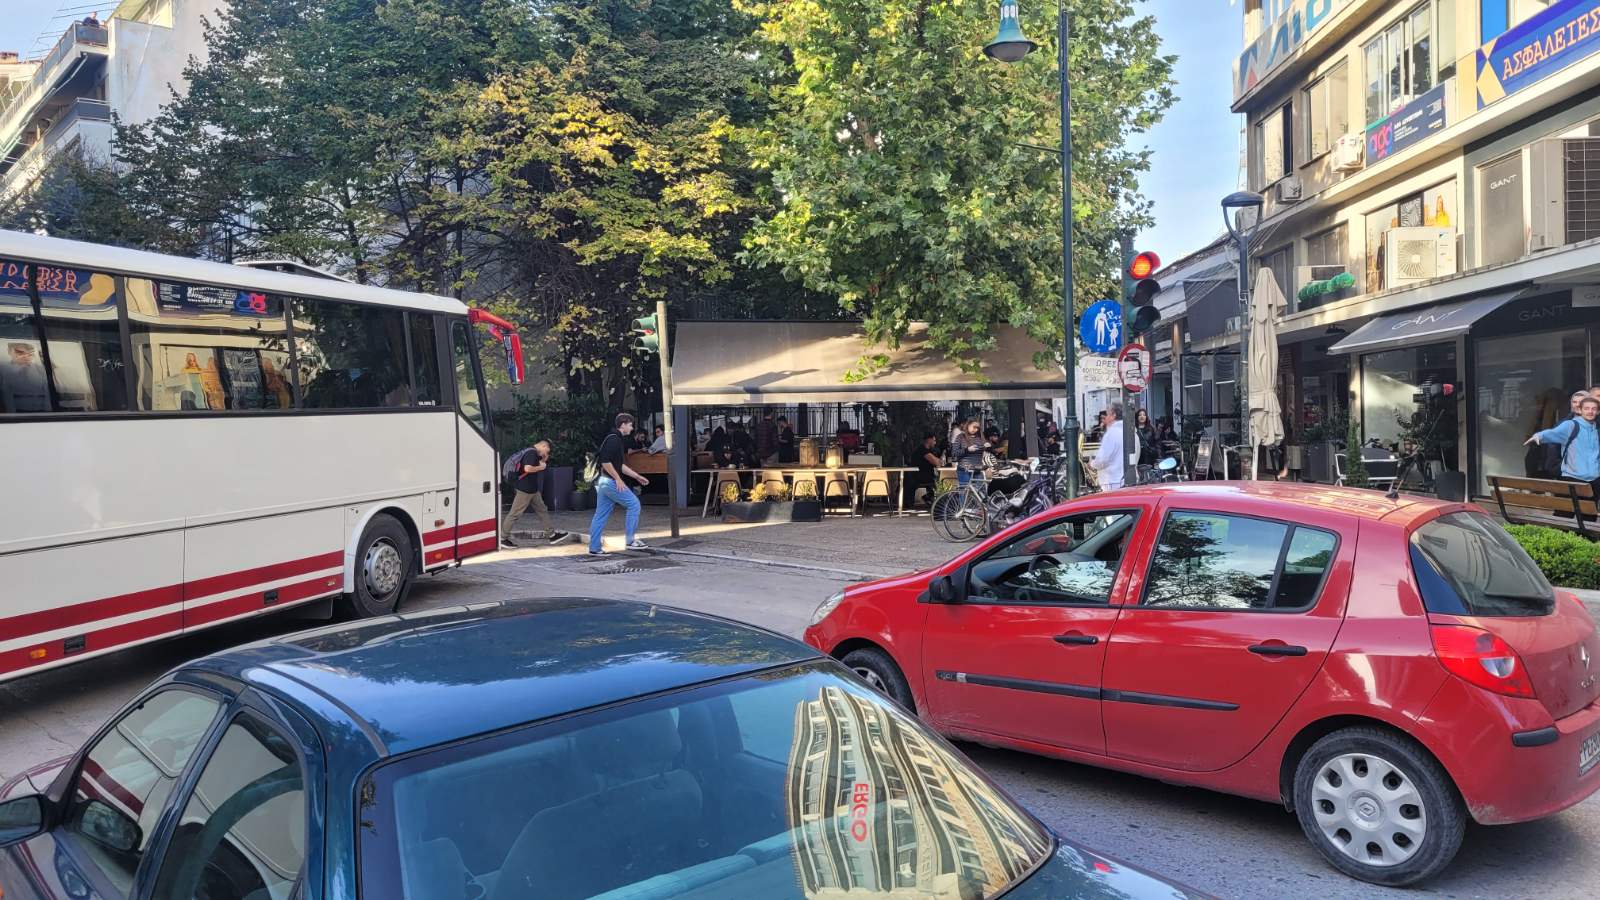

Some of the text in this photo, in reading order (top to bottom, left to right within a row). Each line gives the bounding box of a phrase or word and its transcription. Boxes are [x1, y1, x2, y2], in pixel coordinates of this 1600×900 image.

[1501, 6, 1600, 81] ΑΣΦΑΛΕΙΕΣ
[1490, 174, 1518, 190] GANT
[1518, 303, 1568, 322] GANT
